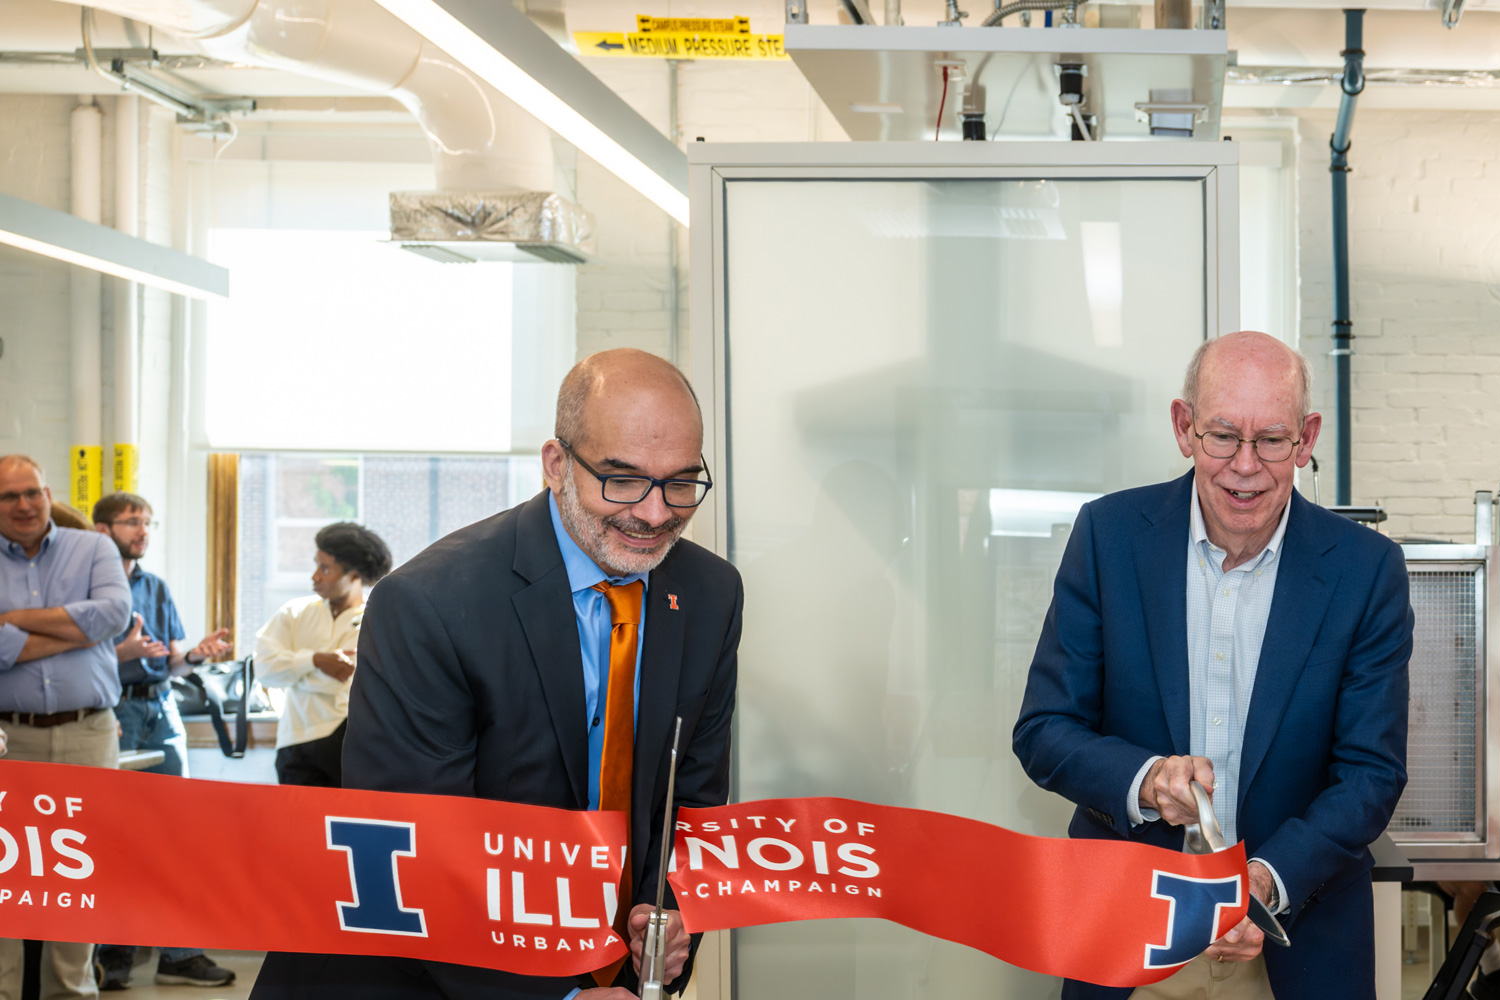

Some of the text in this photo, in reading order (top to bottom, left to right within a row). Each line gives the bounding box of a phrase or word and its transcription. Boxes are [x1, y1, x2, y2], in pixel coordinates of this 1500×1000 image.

[627, 37, 786, 57] MEDIUM PRESSURE STE
[33, 793, 83, 818] OF
[823, 818, 875, 836] OF
[485, 832, 627, 869] UNIVE
